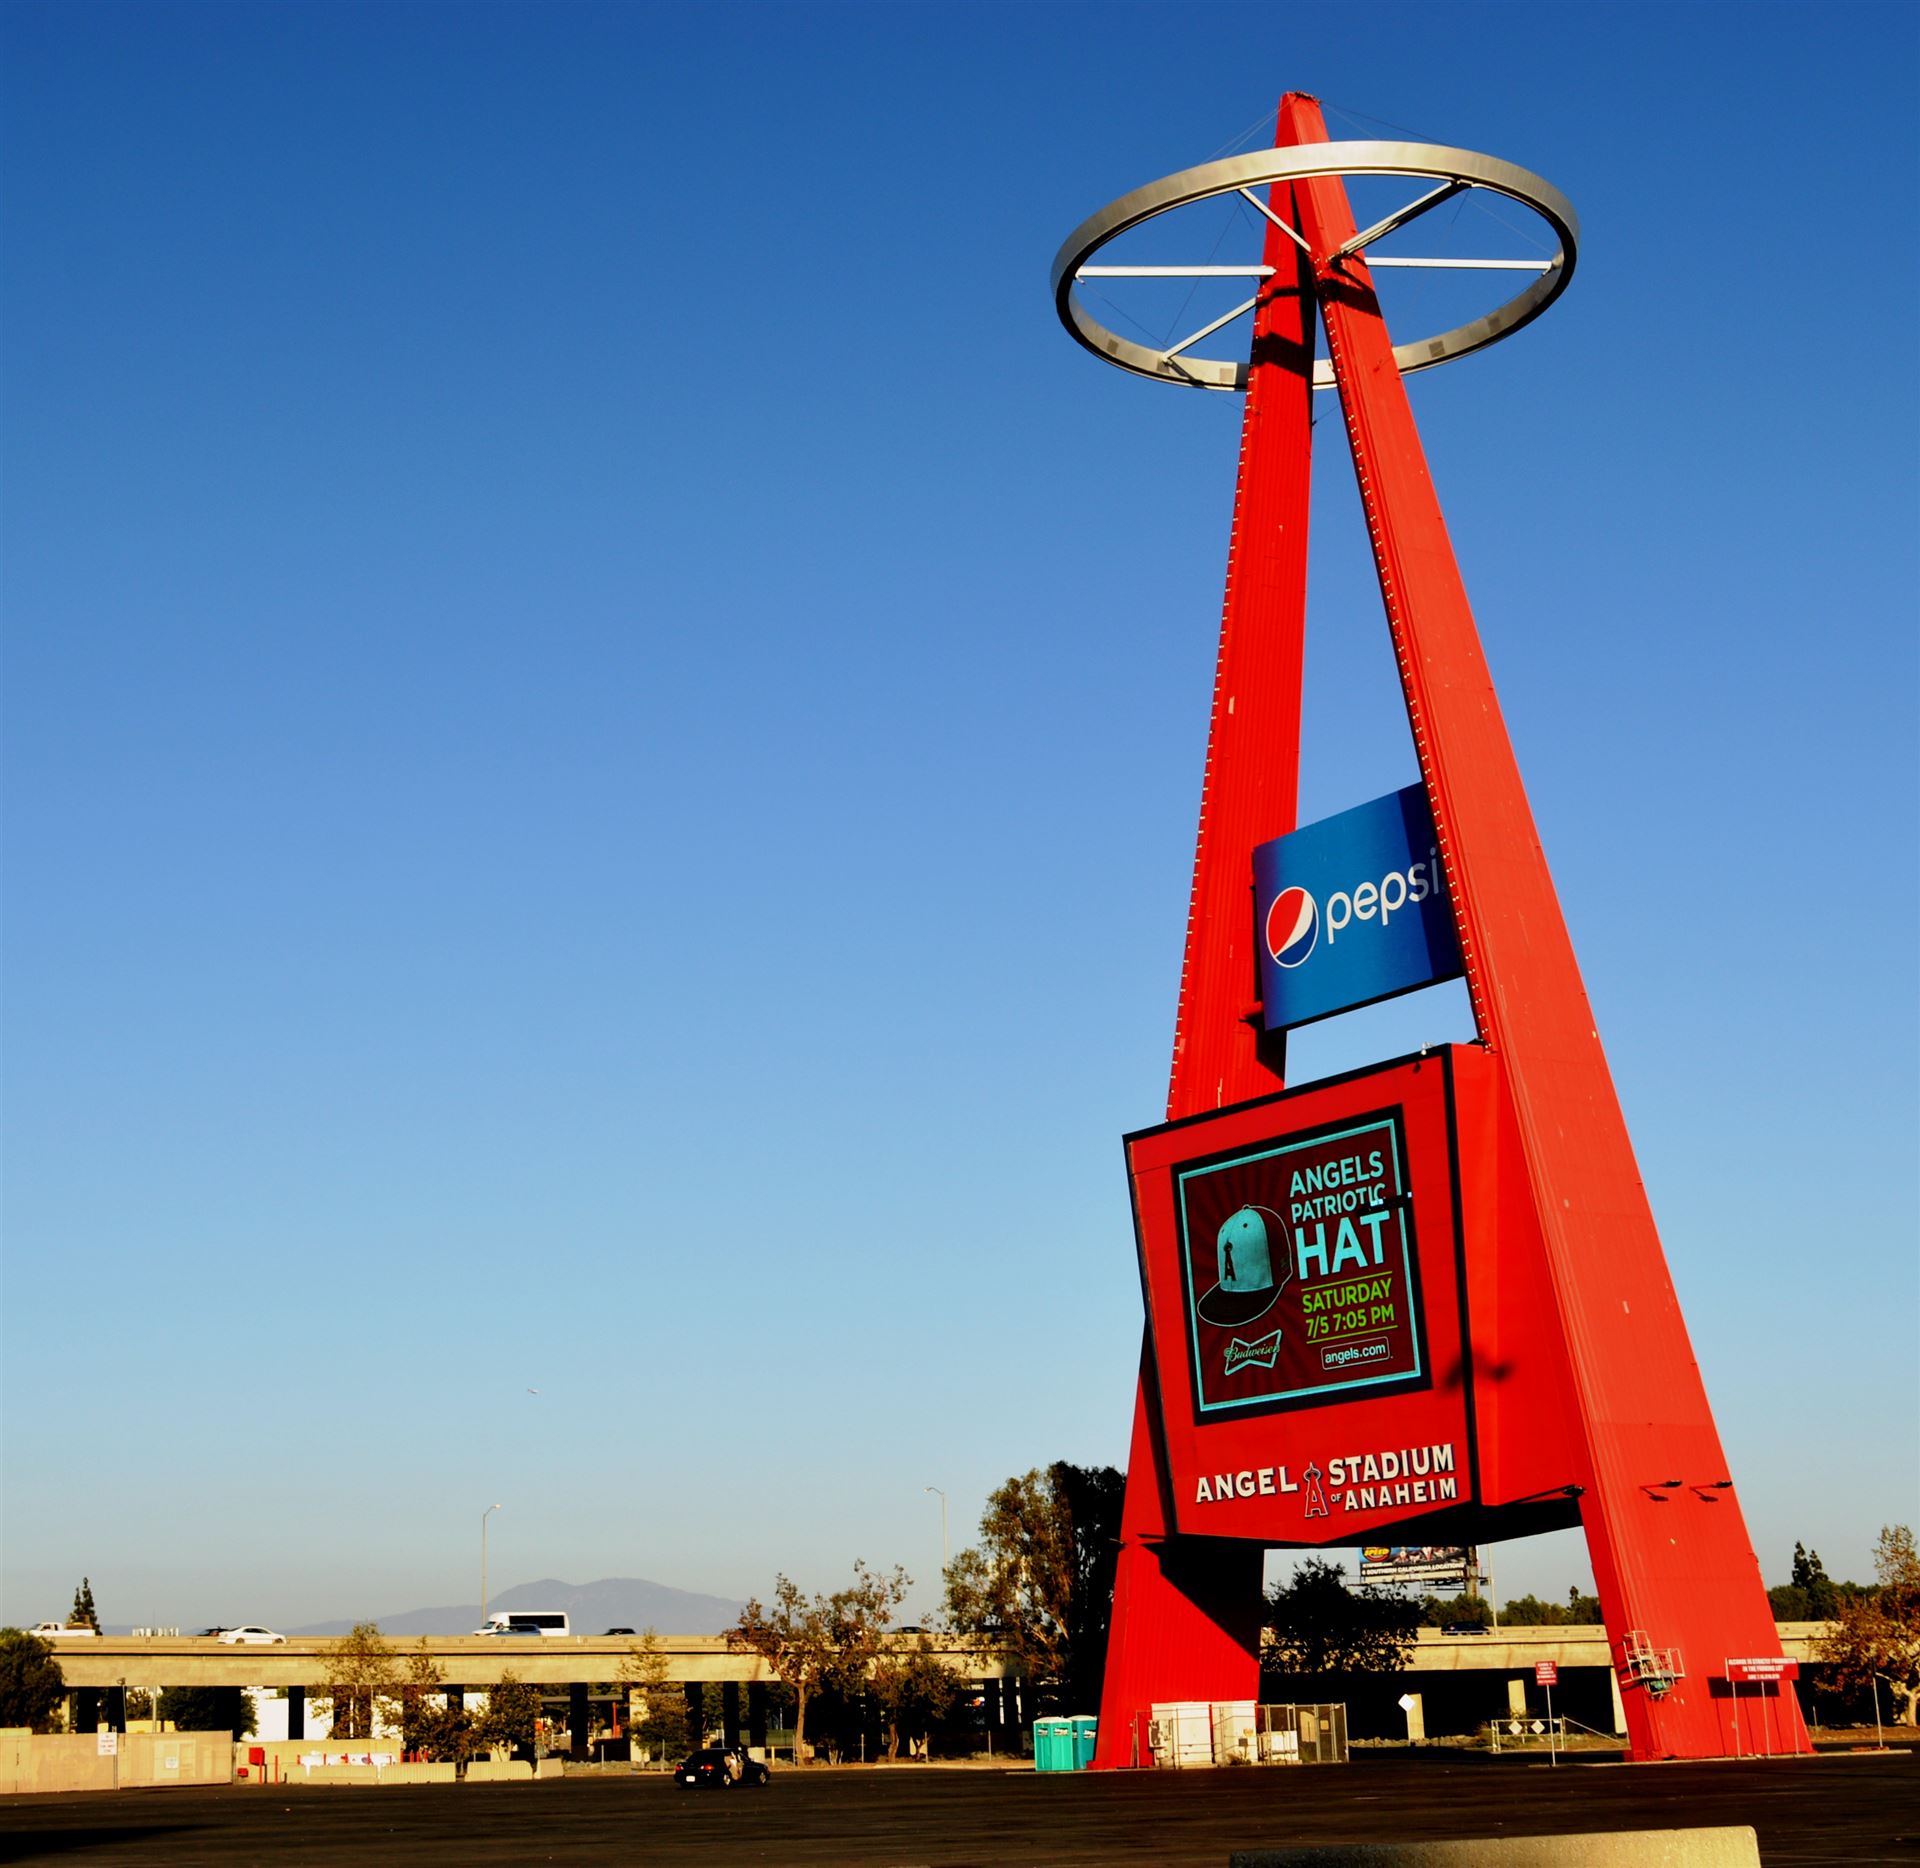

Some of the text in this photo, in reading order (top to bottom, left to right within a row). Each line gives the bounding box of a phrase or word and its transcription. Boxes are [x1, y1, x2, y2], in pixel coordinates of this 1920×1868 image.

[1326, 847, 1439, 945] pepsi
[1289, 1151, 1384, 1198] ANGELS
[1291, 1183, 1386, 1224] PATRIOTIC
[1295, 1210, 1390, 1280] HAT
[1302, 1278, 1392, 1313] SATURDAY
[1305, 1303, 1395, 1339] 7/5 7:05 PM
[1224, 1344, 1280, 1362] Budweiser
[1324, 1343, 1386, 1366] angels.com
[1195, 1465, 1299, 1504] ANGEL
[1328, 1443, 1455, 1486] STADIUM
[1330, 1477, 1458, 1511] OF ANAHEIM
[1397, 1564, 1432, 1573] CALIFORNIA
